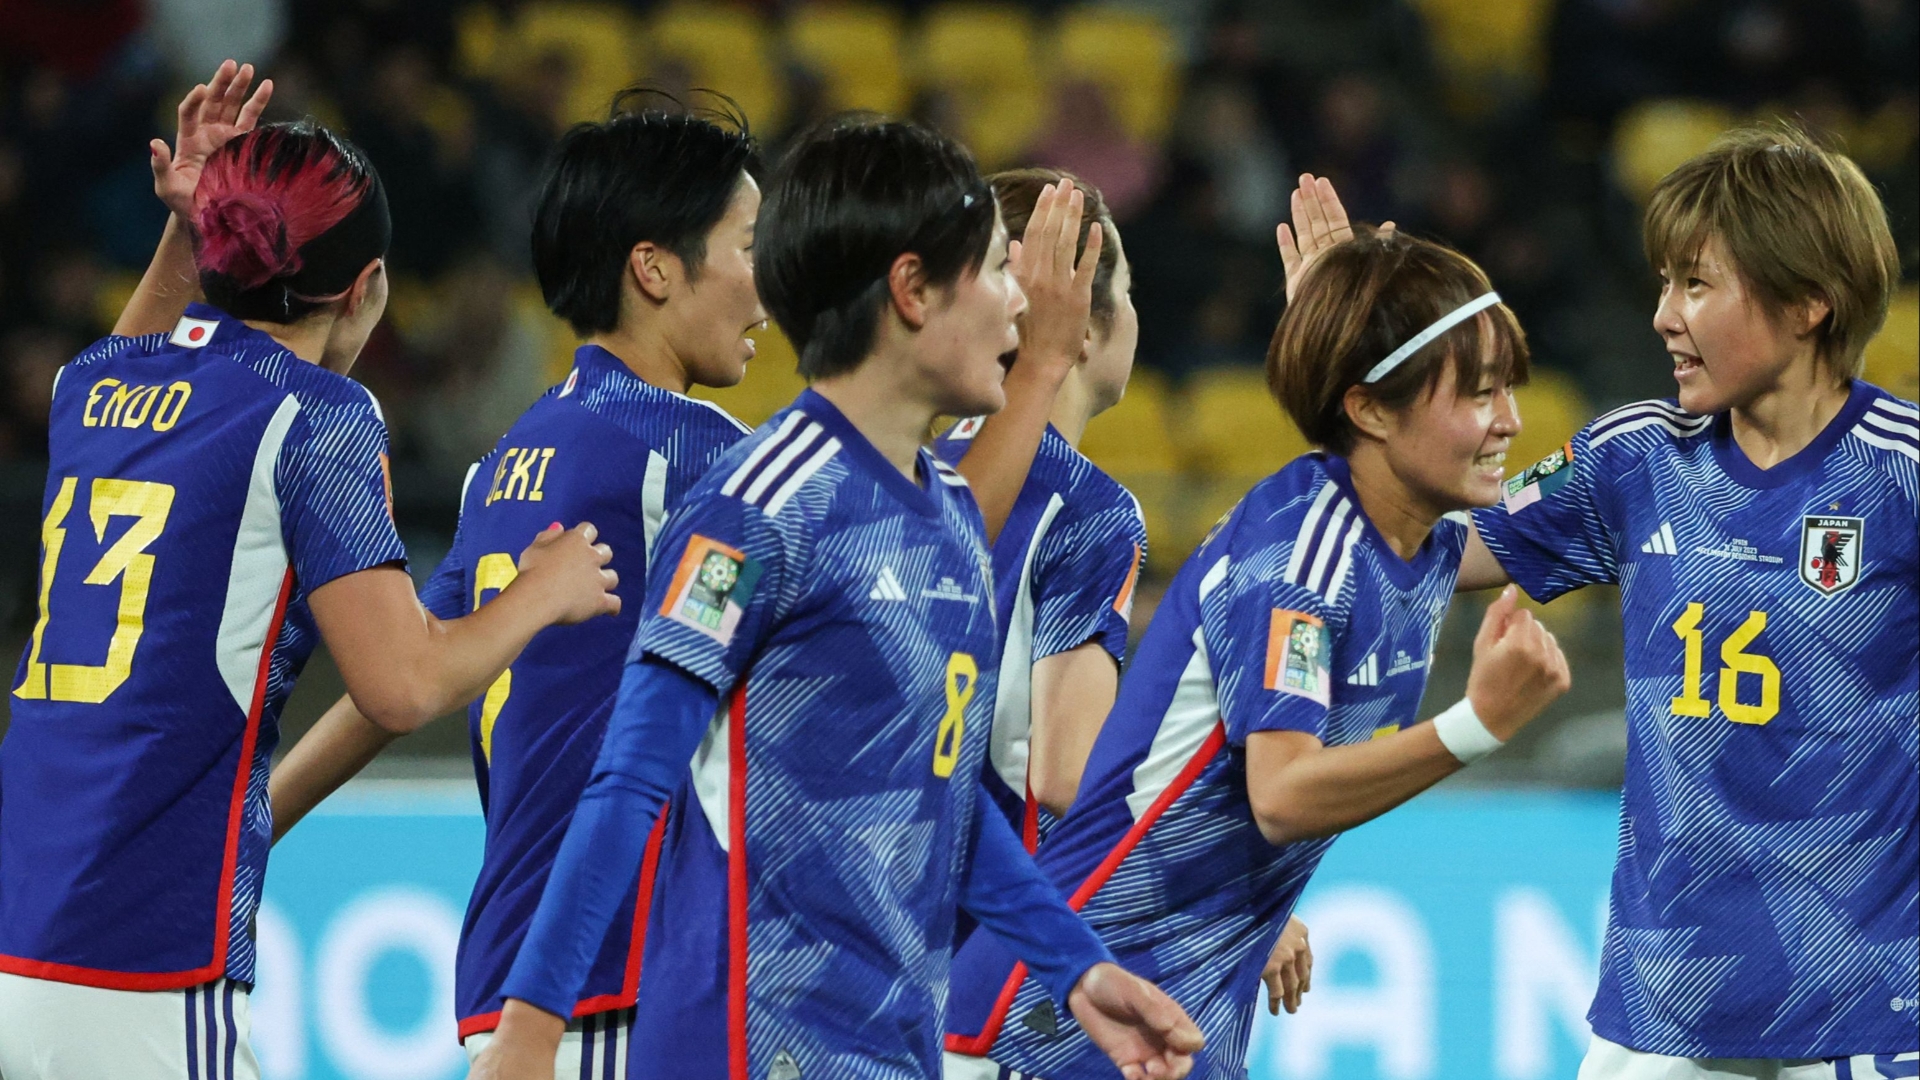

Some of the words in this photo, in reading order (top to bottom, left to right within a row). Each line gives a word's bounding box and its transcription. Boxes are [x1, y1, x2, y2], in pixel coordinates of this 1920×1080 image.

[83, 377, 192, 432] ENDO
[1817, 519, 1849, 527] JAPAN
[1743, 546, 1758, 554] 2023
[1758, 555, 1783, 564] STADIUM
[12, 476, 176, 704] 13
[1815, 570, 1842, 583] JFA
[1670, 602, 1781, 726] 16
[932, 651, 979, 778] 8
